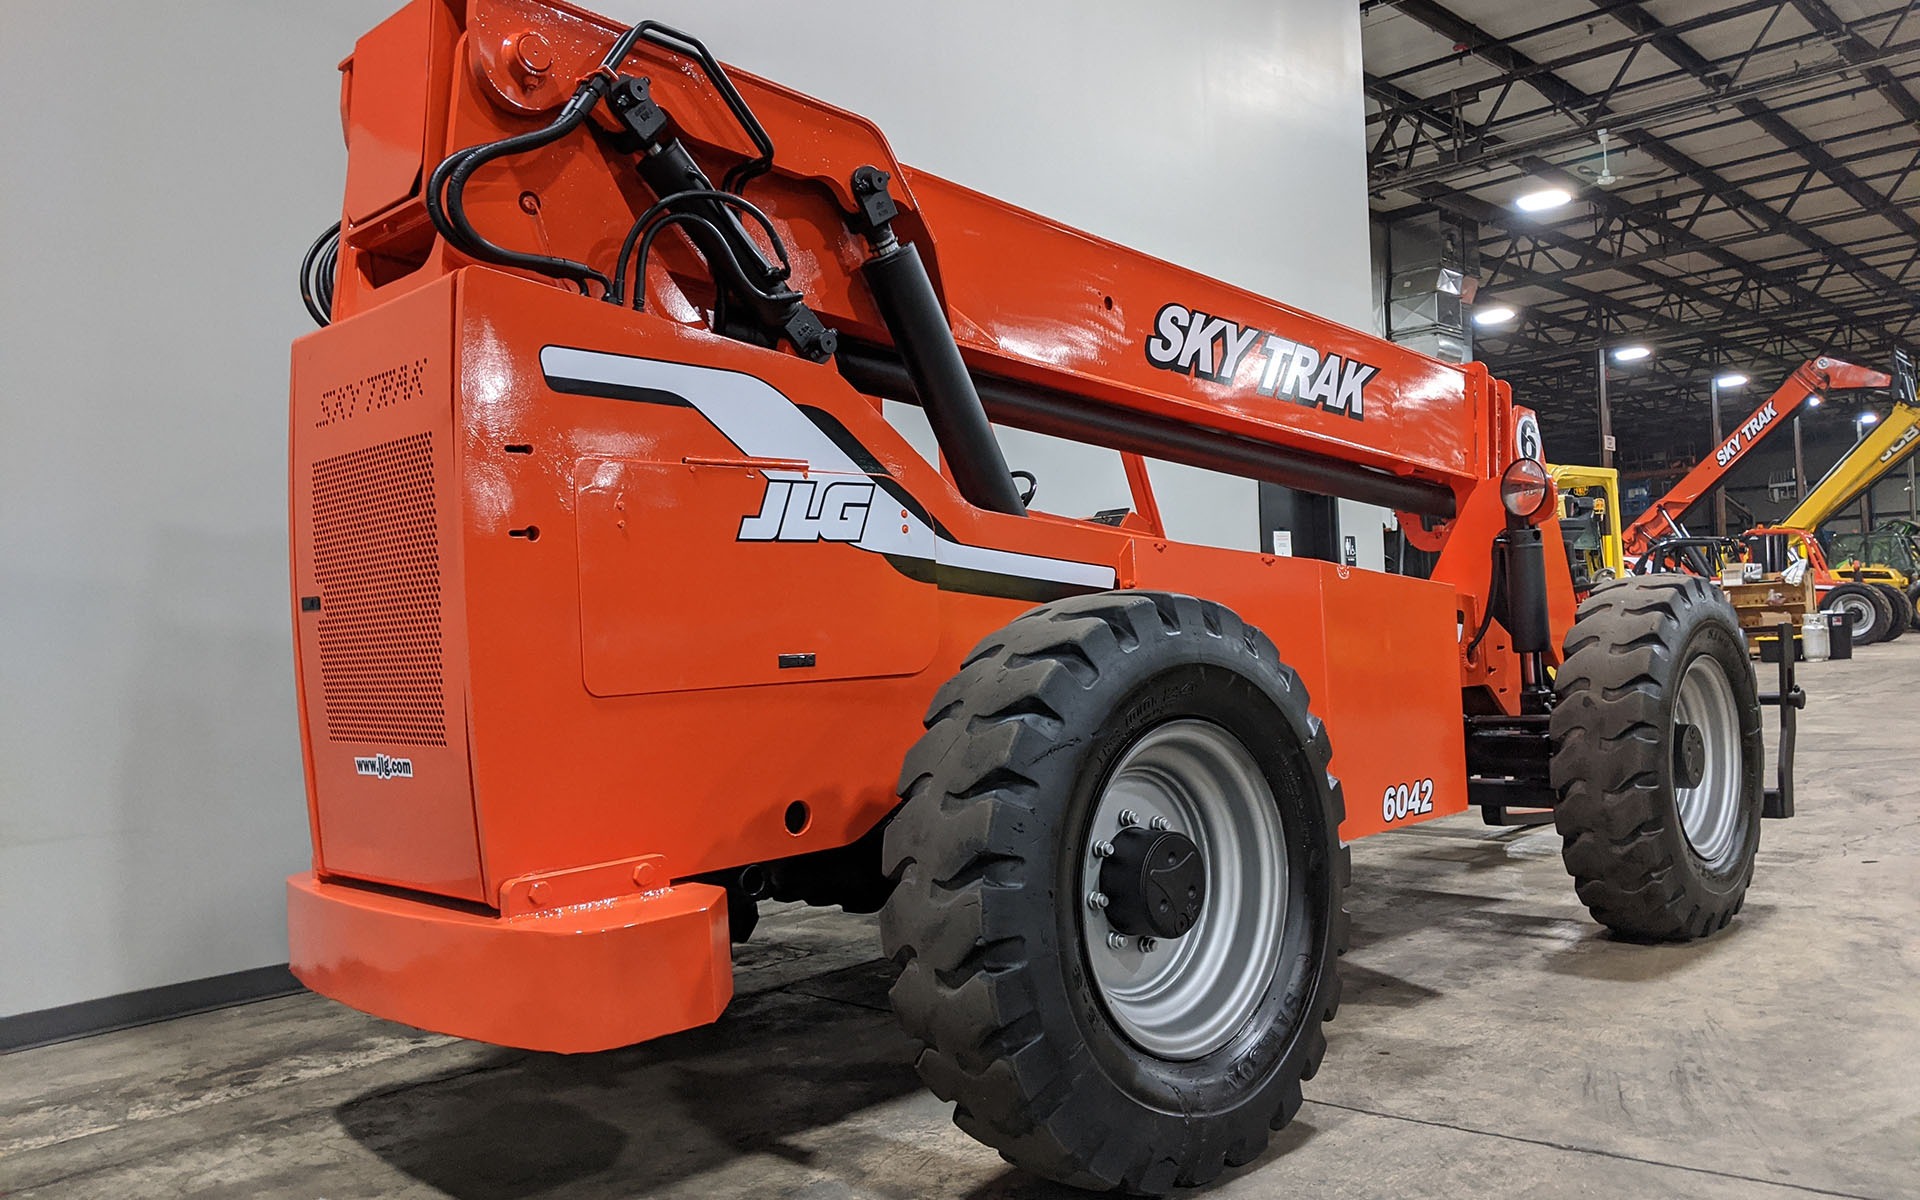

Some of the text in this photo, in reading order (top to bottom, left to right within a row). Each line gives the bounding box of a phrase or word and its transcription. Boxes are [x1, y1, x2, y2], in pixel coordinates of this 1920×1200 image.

[316, 358, 428, 428] SKY TRAK
[1145, 303, 1381, 421] SKY TRAK
[1520, 420, 1537, 460] 6
[1716, 400, 1778, 467] SKY TRAK
[736, 480, 876, 543] JLG
[356, 756, 412, 777] www.jlg.com
[1382, 778, 1434, 823] 6042
